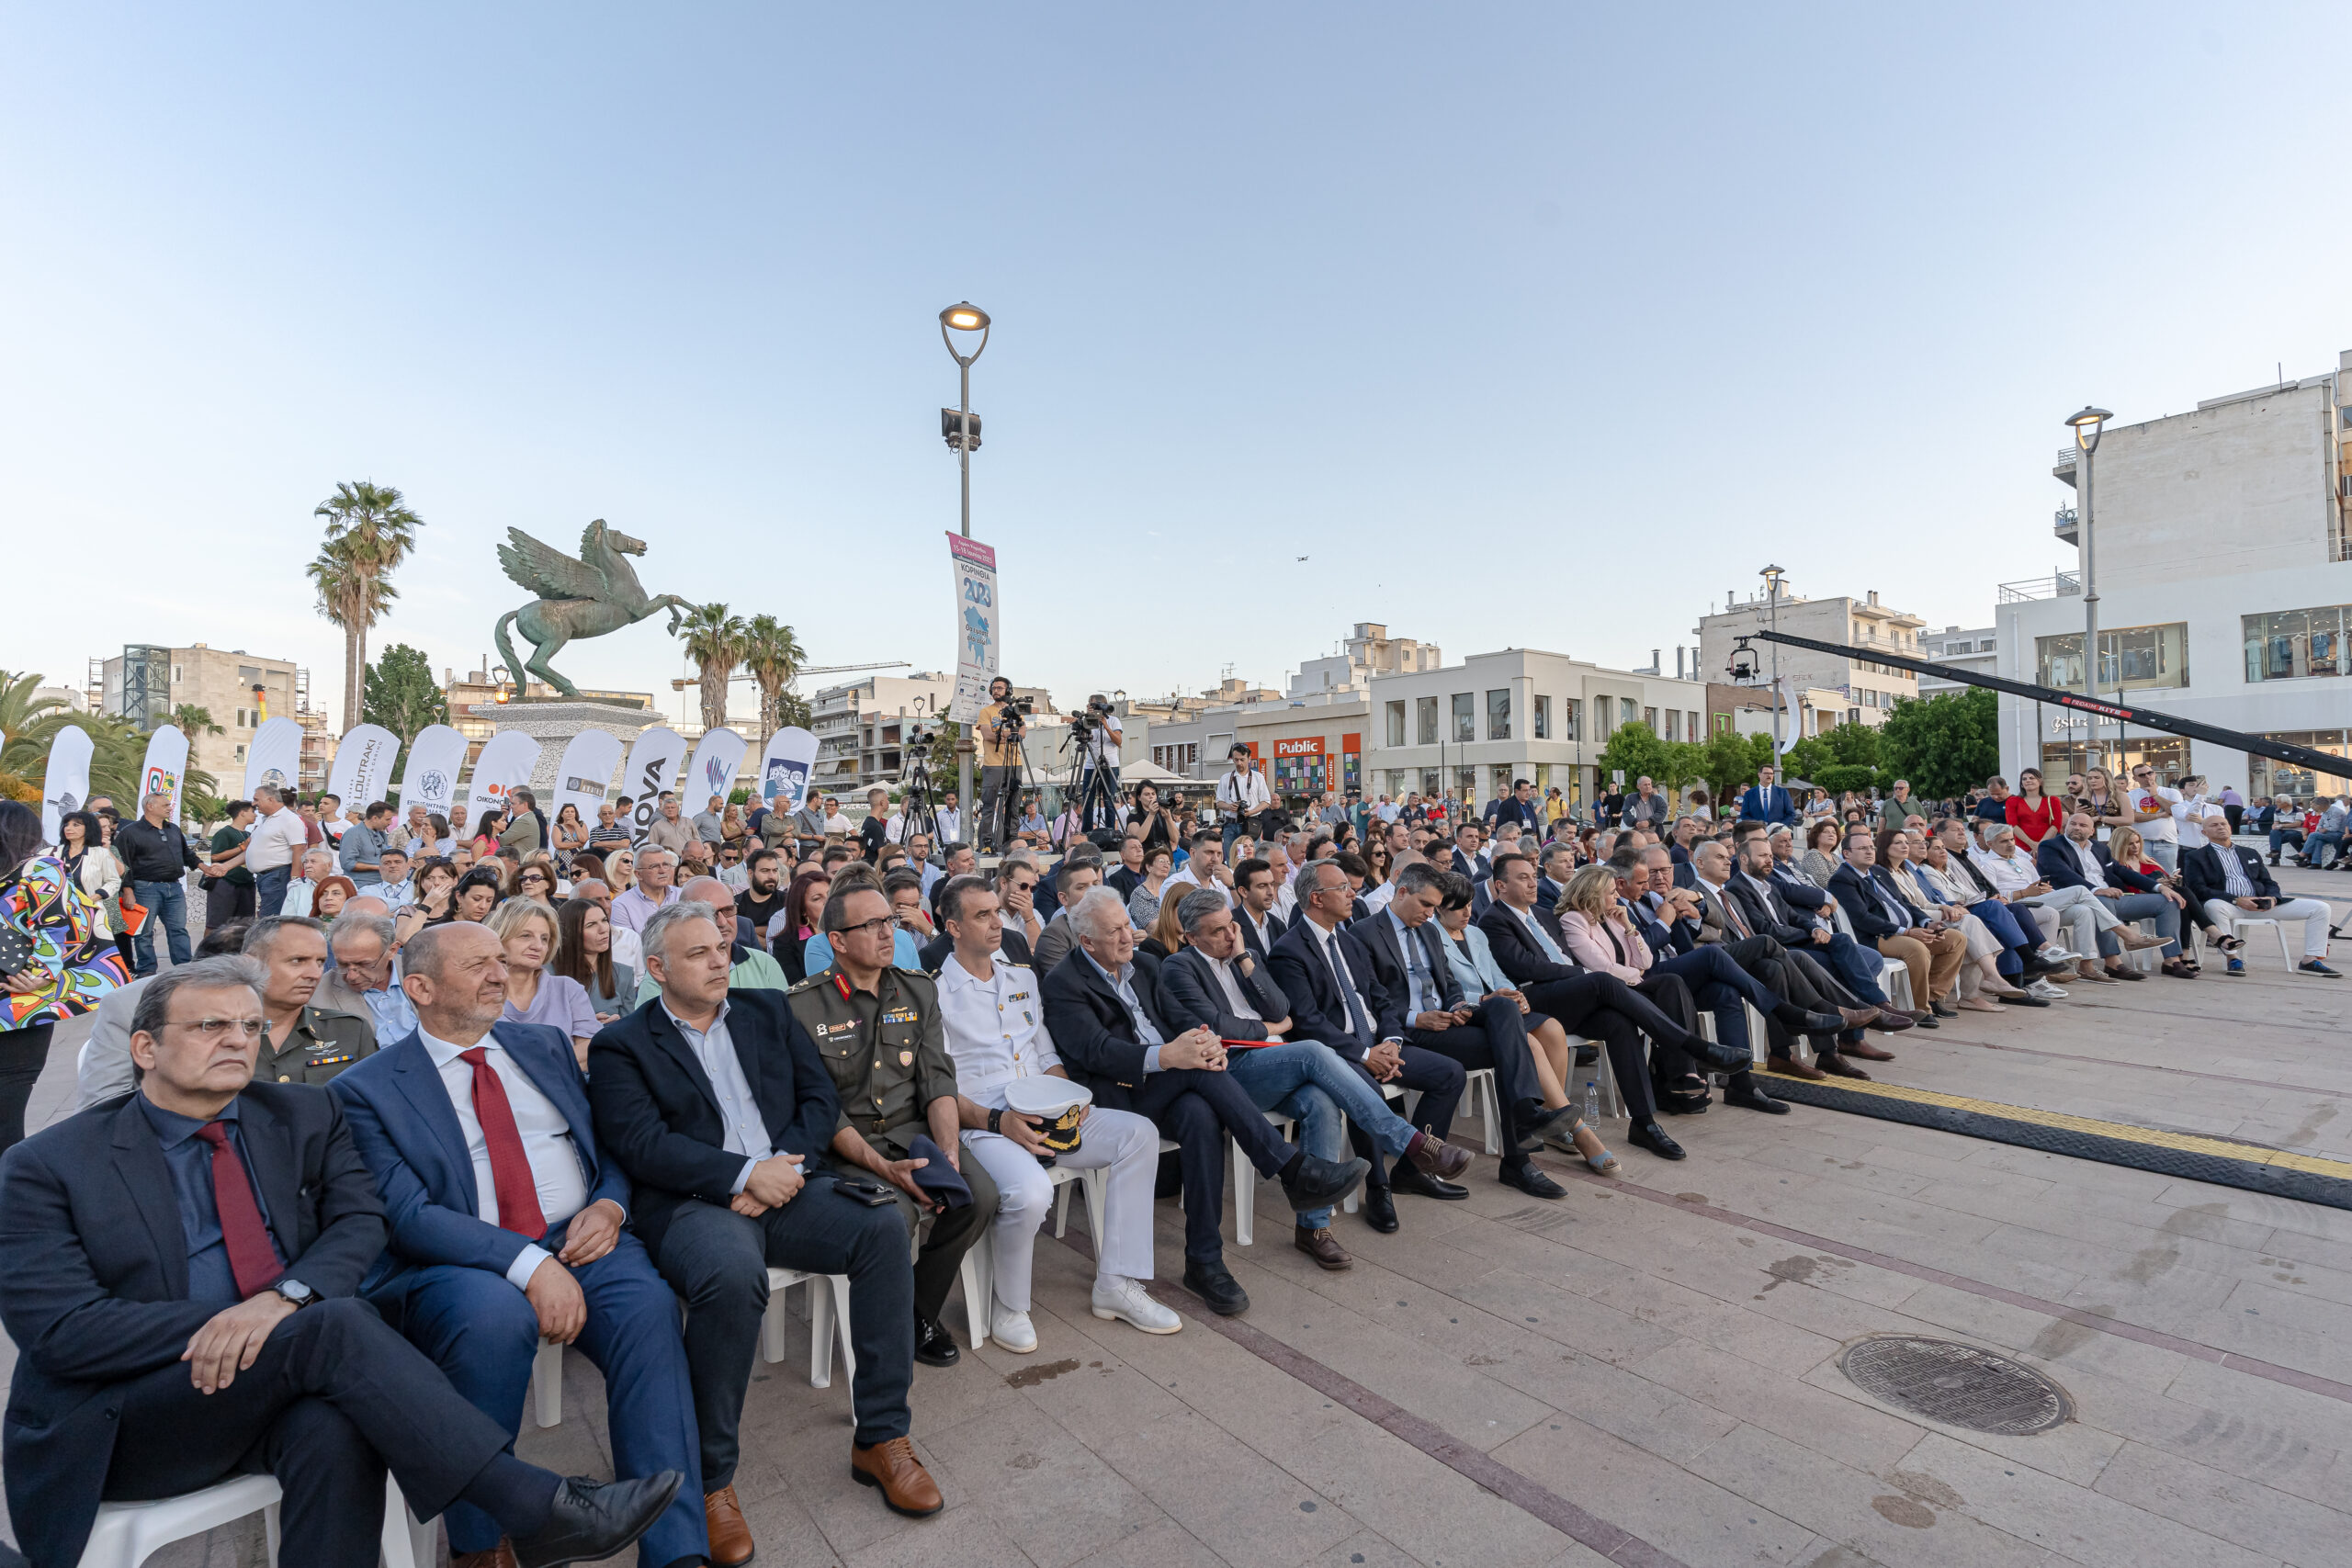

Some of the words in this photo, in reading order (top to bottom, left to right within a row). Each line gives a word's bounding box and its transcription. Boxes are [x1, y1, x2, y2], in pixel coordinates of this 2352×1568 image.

[961, 563, 990, 581] ΚΟΡΙΝΘΙΑ
[964, 577, 992, 607] 2023
[1279, 740, 1318, 753] Public
[354, 739, 377, 799] LOUTRAKI
[632, 758, 667, 852] NOVA
